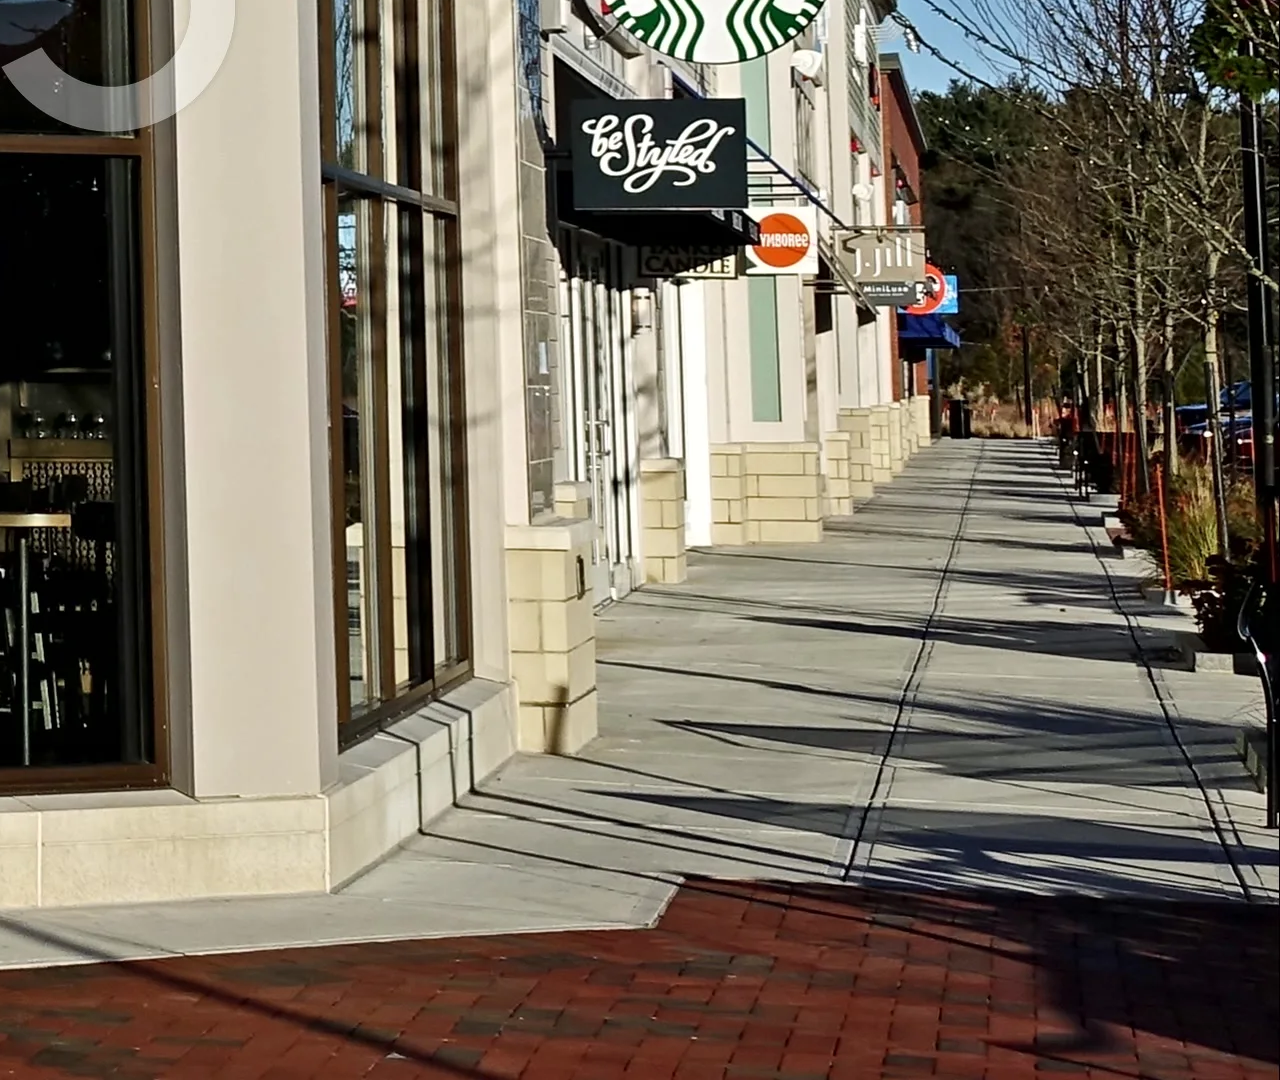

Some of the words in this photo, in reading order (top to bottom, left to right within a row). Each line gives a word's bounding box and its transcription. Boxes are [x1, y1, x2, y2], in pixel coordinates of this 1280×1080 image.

[582, 114, 624, 158] be
[599, 113, 736, 194] Styled
[759, 233, 809, 248] YMBORee
[645, 256, 731, 274] CANDLE
